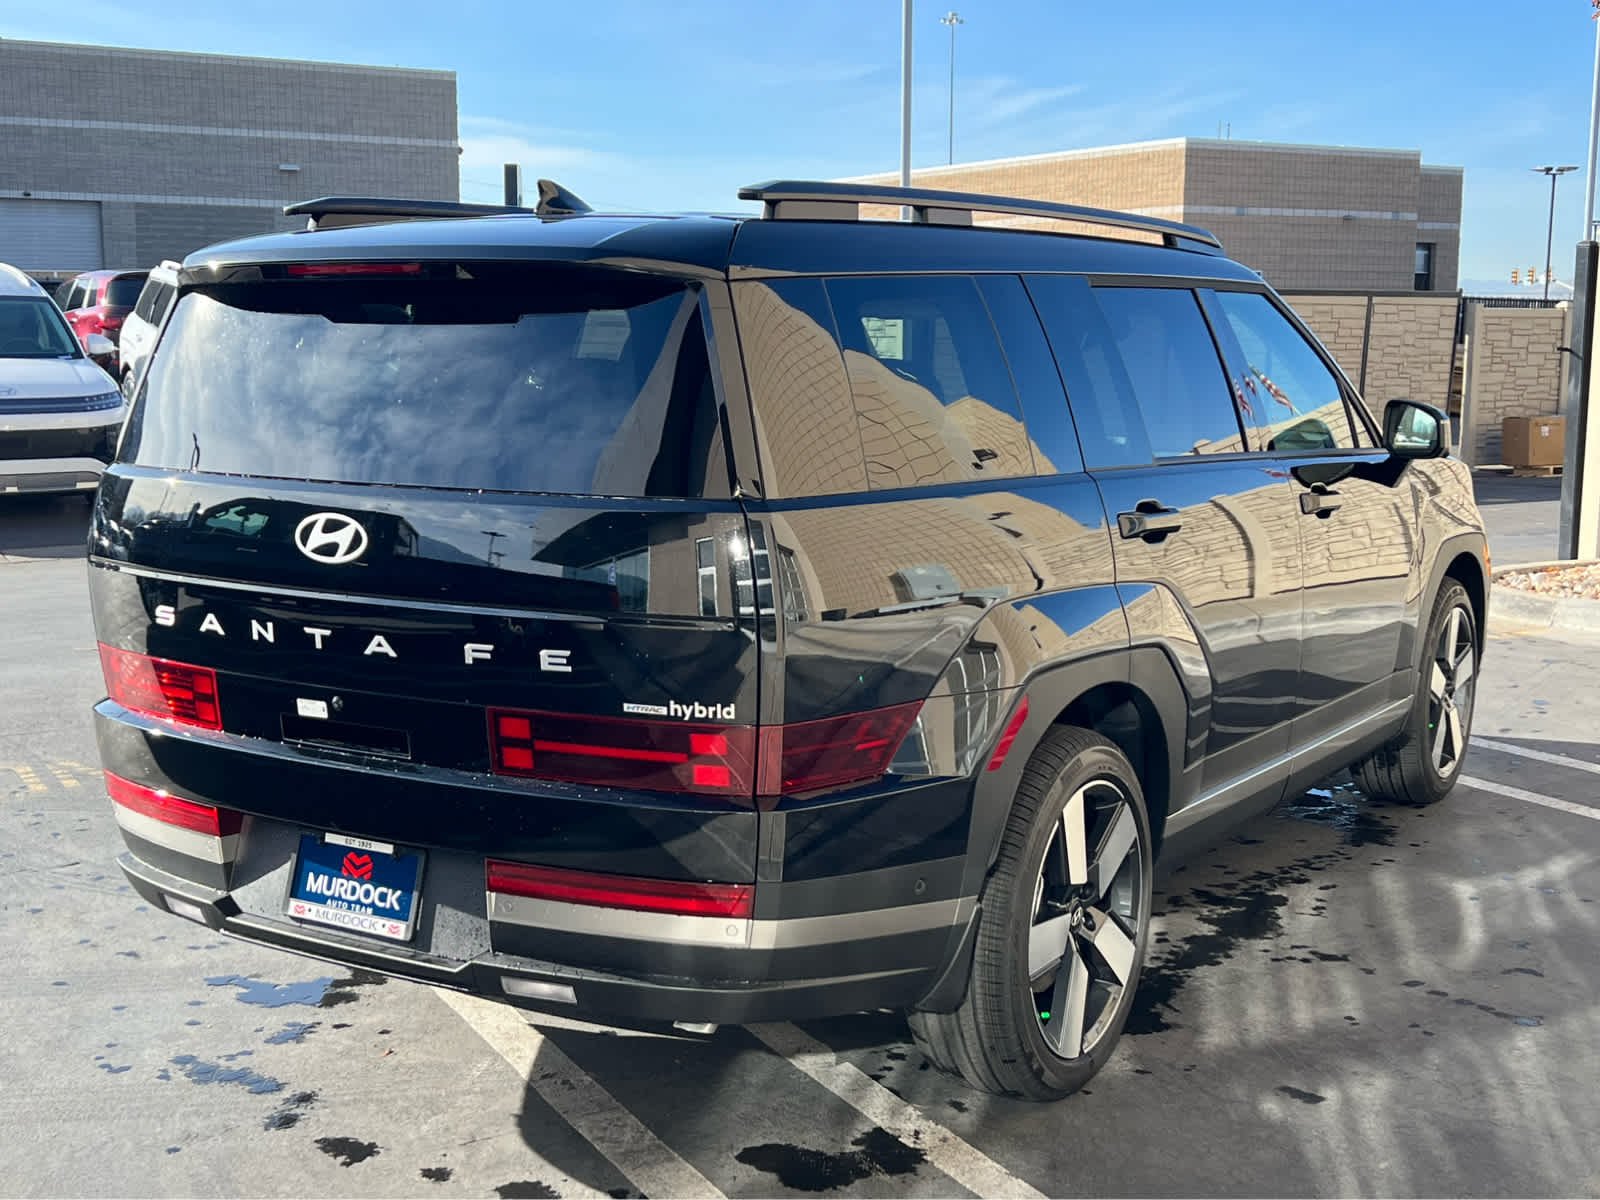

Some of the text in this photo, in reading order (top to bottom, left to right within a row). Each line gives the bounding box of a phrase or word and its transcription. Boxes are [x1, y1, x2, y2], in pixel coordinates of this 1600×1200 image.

[154, 604, 572, 673] SANTA FE
[669, 700, 735, 720] hybrid
[305, 871, 402, 911] MURDOCK
[326, 898, 374, 915] AUTO TEAM
[314, 907, 380, 930] MURDOCK
